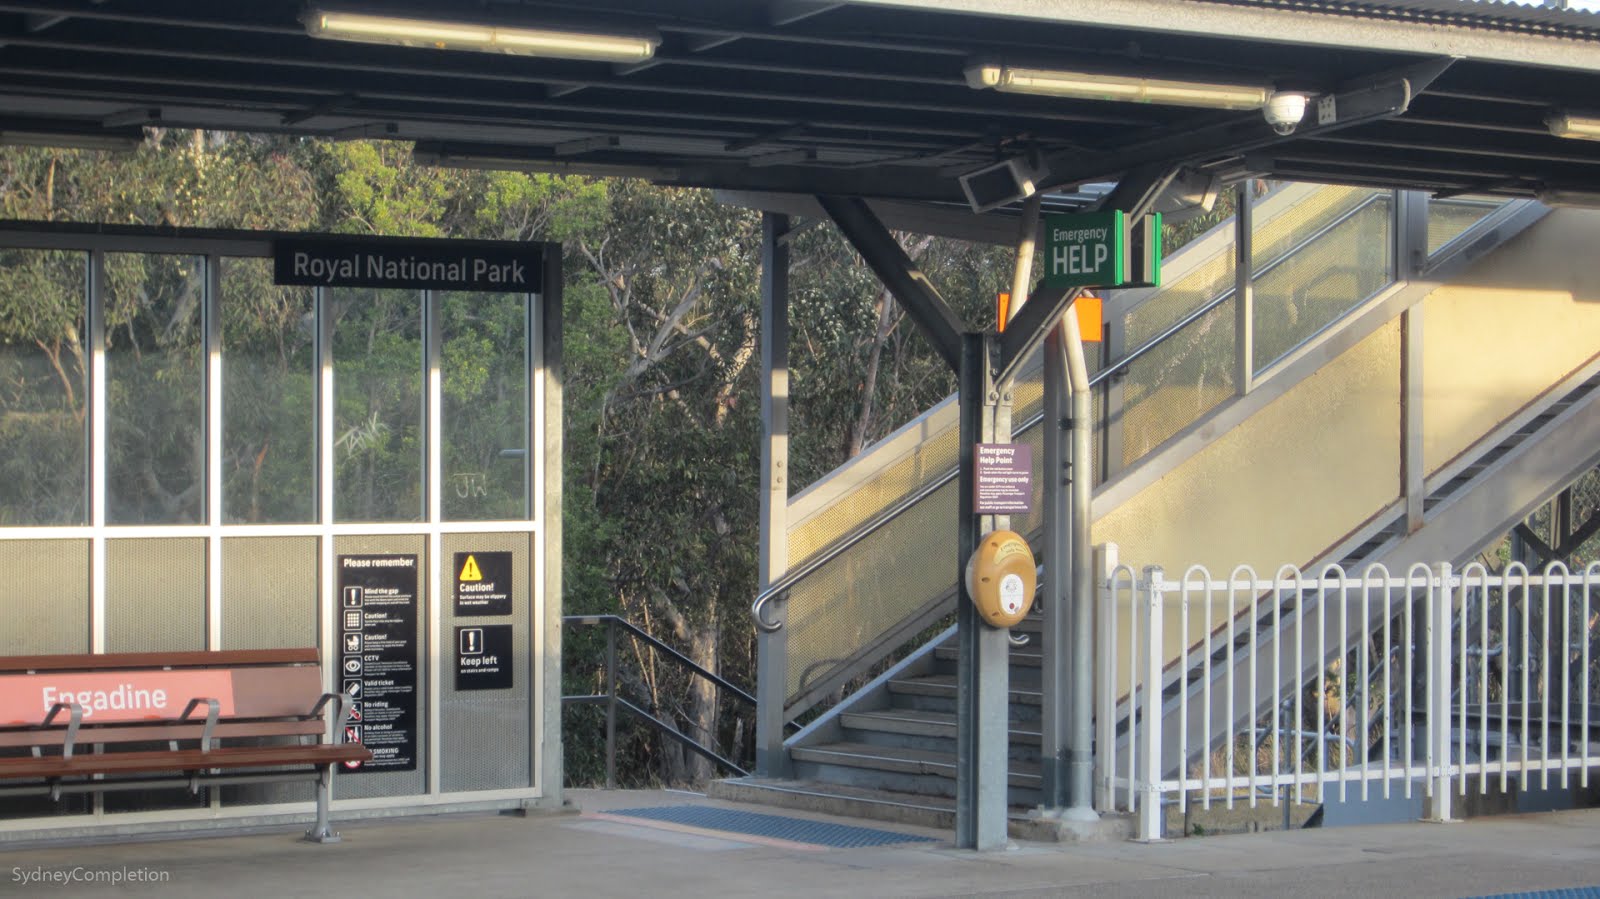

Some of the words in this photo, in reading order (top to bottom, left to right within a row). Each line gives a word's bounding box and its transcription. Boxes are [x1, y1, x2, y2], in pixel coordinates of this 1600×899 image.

[1053, 227, 1108, 243] Emergency
[1053, 243, 1108, 275] HELP
[293, 252, 359, 282] Royal
[366, 254, 466, 281] National
[473, 258, 525, 284] Park
[979, 446, 1015, 456] Emergency
[979, 456, 995, 465] Help
[995, 456, 1013, 464] Point
[979, 476, 1007, 484] Emergency
[1018, 476, 1029, 484] only
[344, 558, 371, 568] Please
[372, 557, 414, 567] remember
[388, 588, 399, 596] gap
[459, 582, 494, 592] Caution!
[460, 656, 481, 668] Keep
[482, 655, 498, 665] left
[42, 684, 167, 718] Engadine
[372, 701, 389, 709] riding
[373, 747, 399, 755] SMOKING
